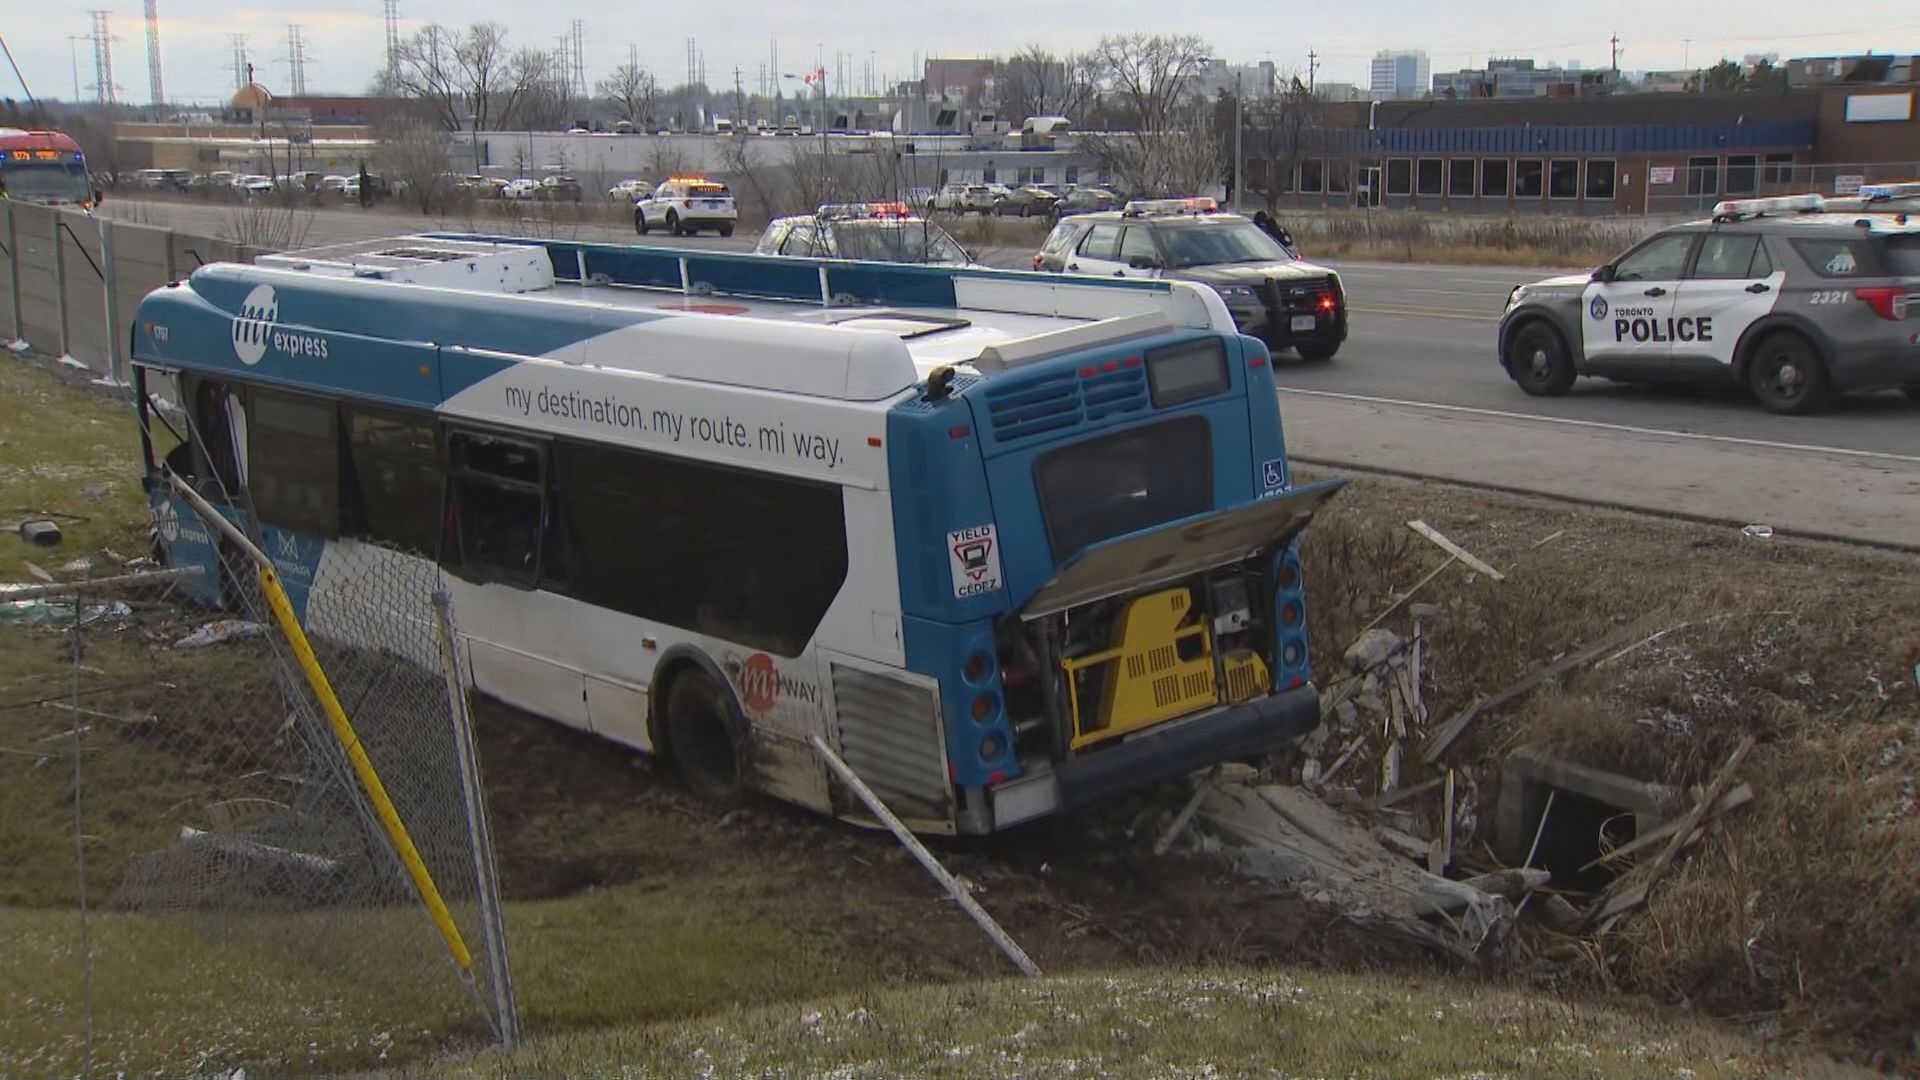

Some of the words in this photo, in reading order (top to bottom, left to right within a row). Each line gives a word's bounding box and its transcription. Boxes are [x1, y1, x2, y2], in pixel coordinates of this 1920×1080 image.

[1809, 291, 1848, 305] 2321
[1615, 307, 1653, 317] TORONTO
[1615, 317, 1712, 343] POLICE
[274, 331, 328, 358] express
[505, 386, 531, 416] my
[538, 386, 647, 431] destination.
[653, 409, 683, 442] my
[690, 415, 752, 448] route.
[759, 421, 785, 454] mi
[793, 433, 844, 468] way.
[952, 526, 990, 542] YIELD
[782, 674, 816, 703] WAY
